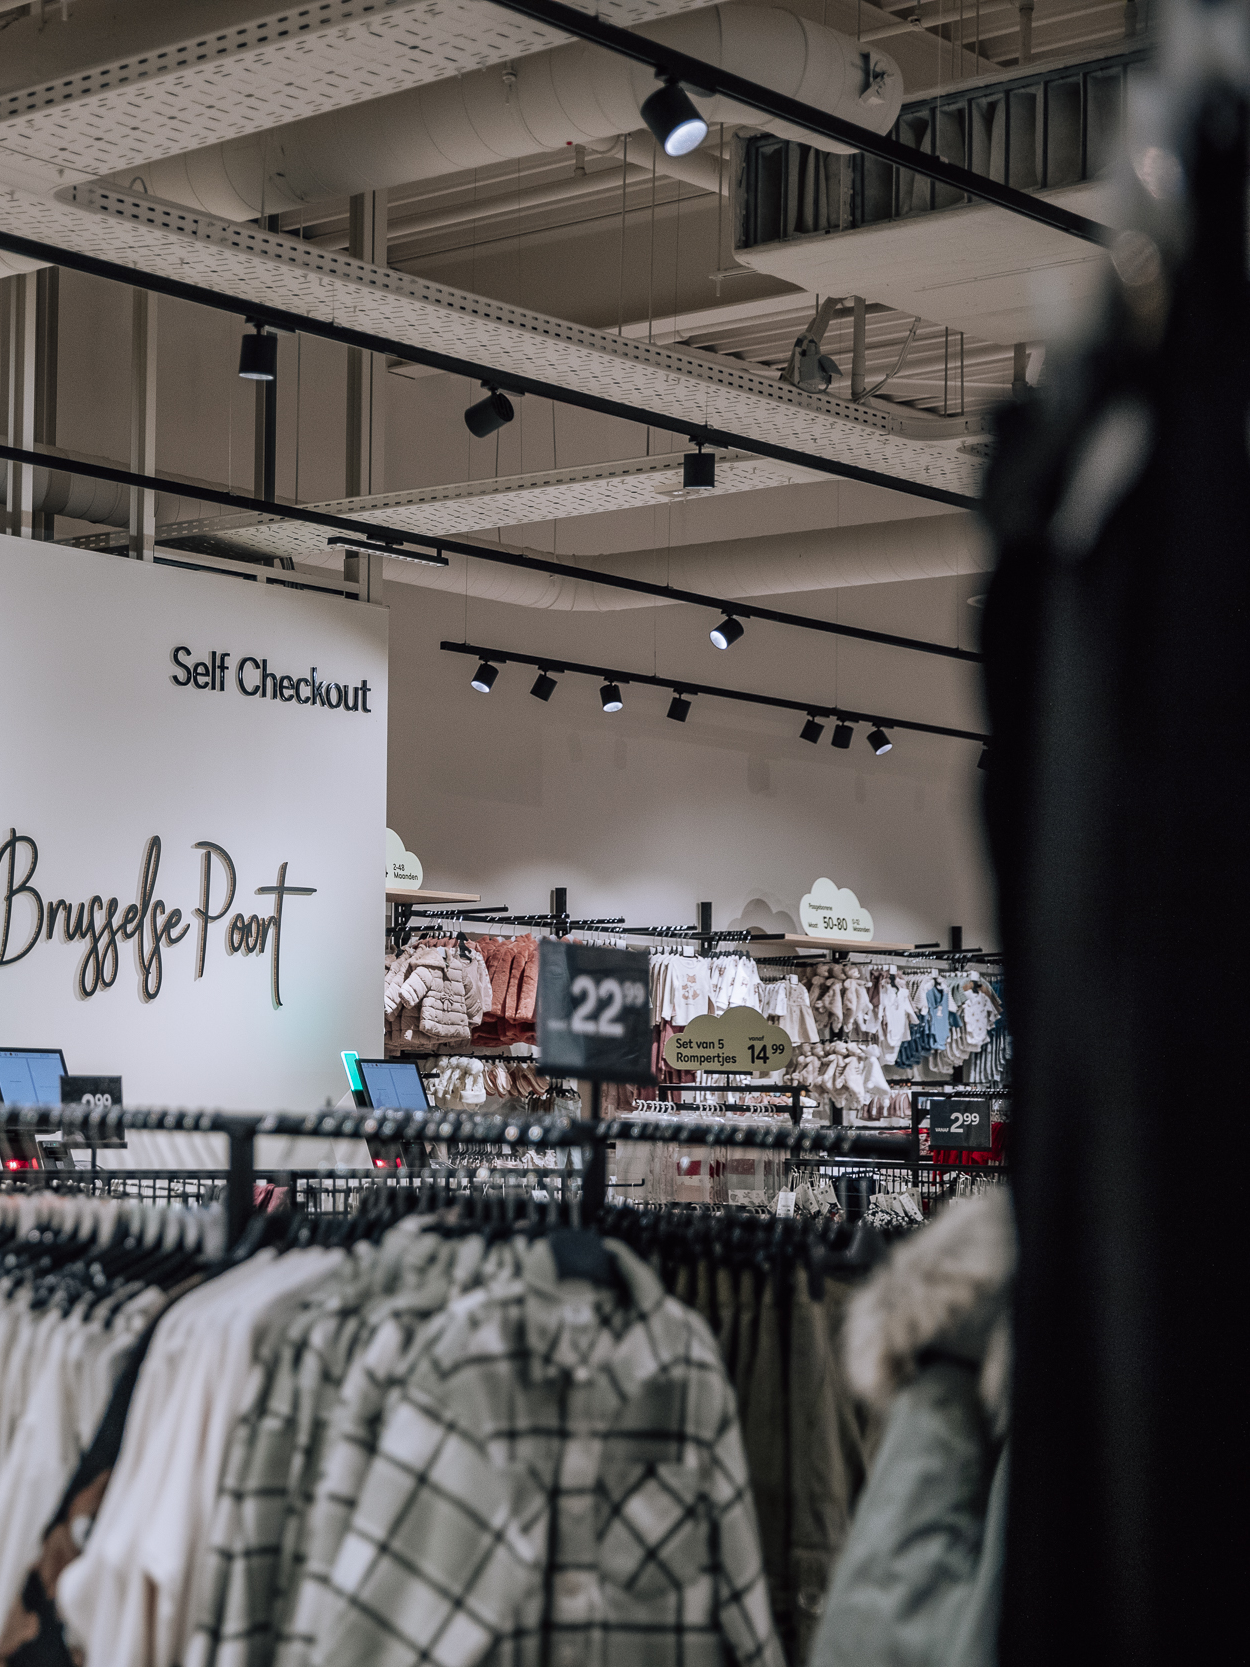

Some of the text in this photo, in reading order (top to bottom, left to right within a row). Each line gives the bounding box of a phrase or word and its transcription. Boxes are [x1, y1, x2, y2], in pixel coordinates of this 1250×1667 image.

[171, 646, 372, 713] Self Checkout
[393, 871, 419, 880] Maanden
[194, 841, 318, 1007] Poort
[823, 916, 847, 931] 50-80
[675, 1038, 725, 1050] Set van 5
[676, 1052, 737, 1066] Rompertjes
